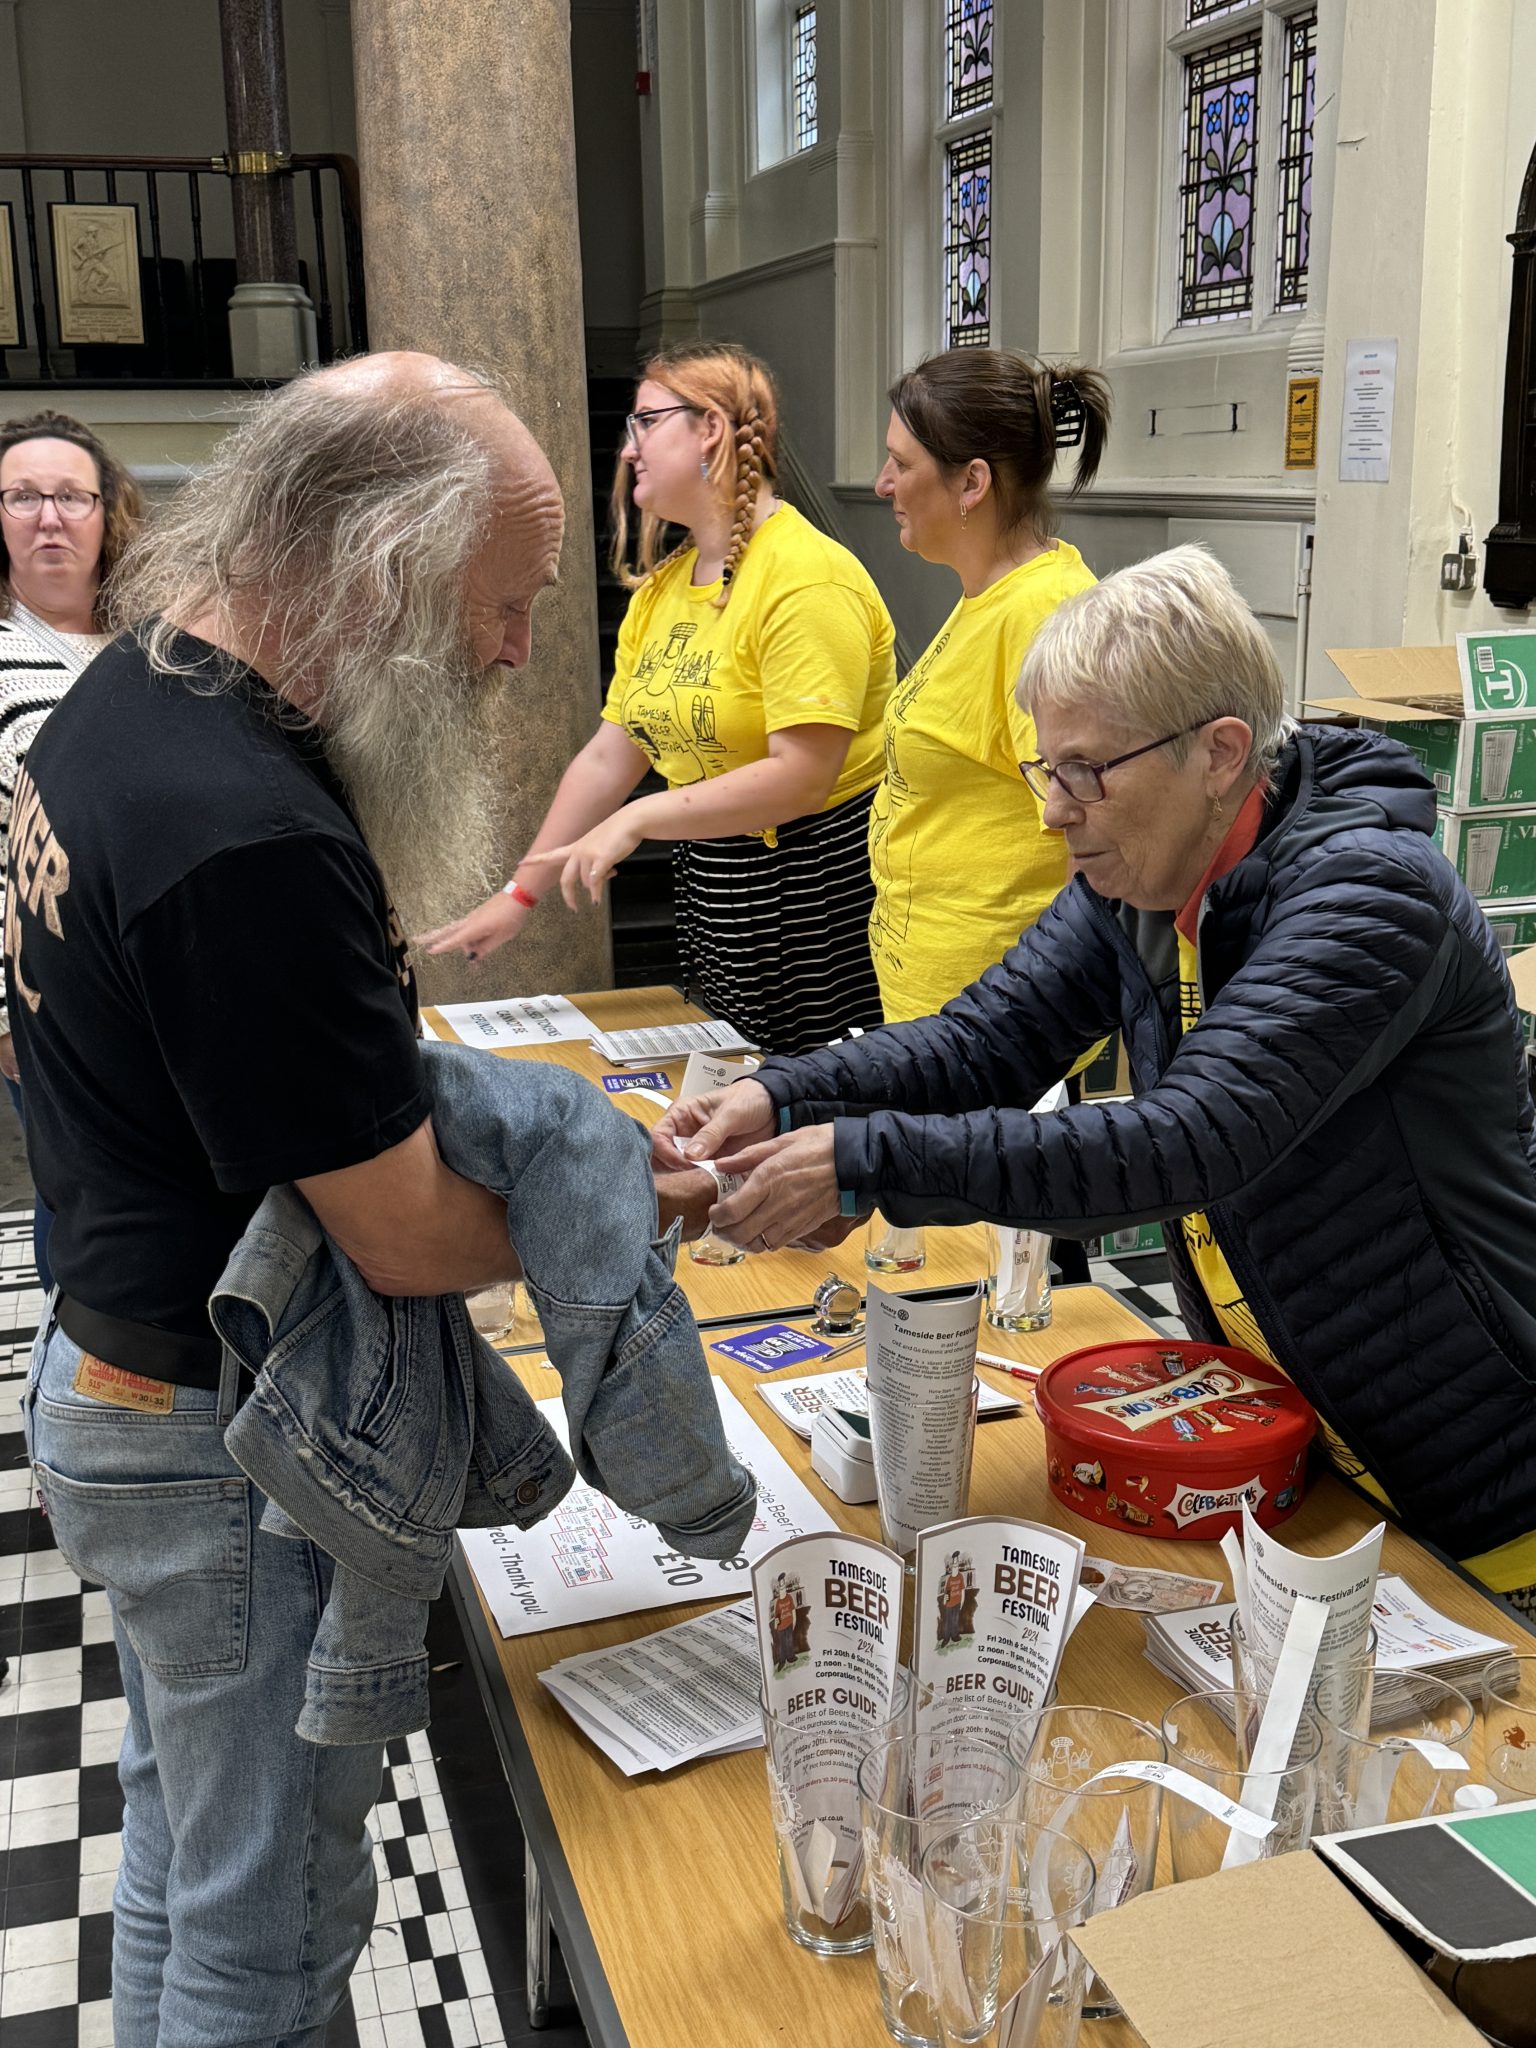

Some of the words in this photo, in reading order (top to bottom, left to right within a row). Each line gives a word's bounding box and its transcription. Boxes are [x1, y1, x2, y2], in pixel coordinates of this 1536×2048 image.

[894, 1323, 935, 1340] Tameside
[936, 1331, 954, 1340] Beer
[792, 1386, 823, 1413] BEER
[767, 1503, 794, 1533] Beer
[499, 1553, 534, 1590] Thank
[653, 1552, 704, 1587] £10
[1002, 1545, 1060, 1579] TAMESIDE
[829, 1560, 887, 1593] TAMESIDE
[994, 1563, 1060, 1615] BEER
[1254, 1560, 1289, 1594] Tameside
[1319, 1585, 1354, 1603] Festival
[1354, 1576, 1370, 1592] 2024
[510, 1591, 548, 1615] you!
[824, 1578, 889, 1630] BEER
[1002, 1598, 1049, 1632] FESTIVAL
[835, 1611, 884, 1645] FESTIVAL
[986, 1634, 997, 1642] Fri
[998, 1636, 1014, 1646] 20th
[1022, 1627, 1040, 1646] 2024
[834, 1649, 850, 1658] 20th
[857, 1638, 875, 1658] 2024
[986, 1646, 1005, 1655] noon
[1184, 1628, 1227, 1662] TAMESIDE
[815, 1671, 856, 1681] Corporation
[977, 1655, 1017, 1671] Corporation
[787, 1688, 827, 1715] BEER
[832, 1687, 877, 1719] GUIDE
[946, 1673, 986, 1694] BEER
[992, 1676, 1034, 1709] GUIDE
[976, 1694, 985, 1702] of
[987, 1695, 1007, 1707] Beers
[806, 1710, 817, 1719] list
[818, 1708, 827, 1717] of
[828, 1708, 849, 1717] Beers
[816, 1749, 846, 1758] Company
